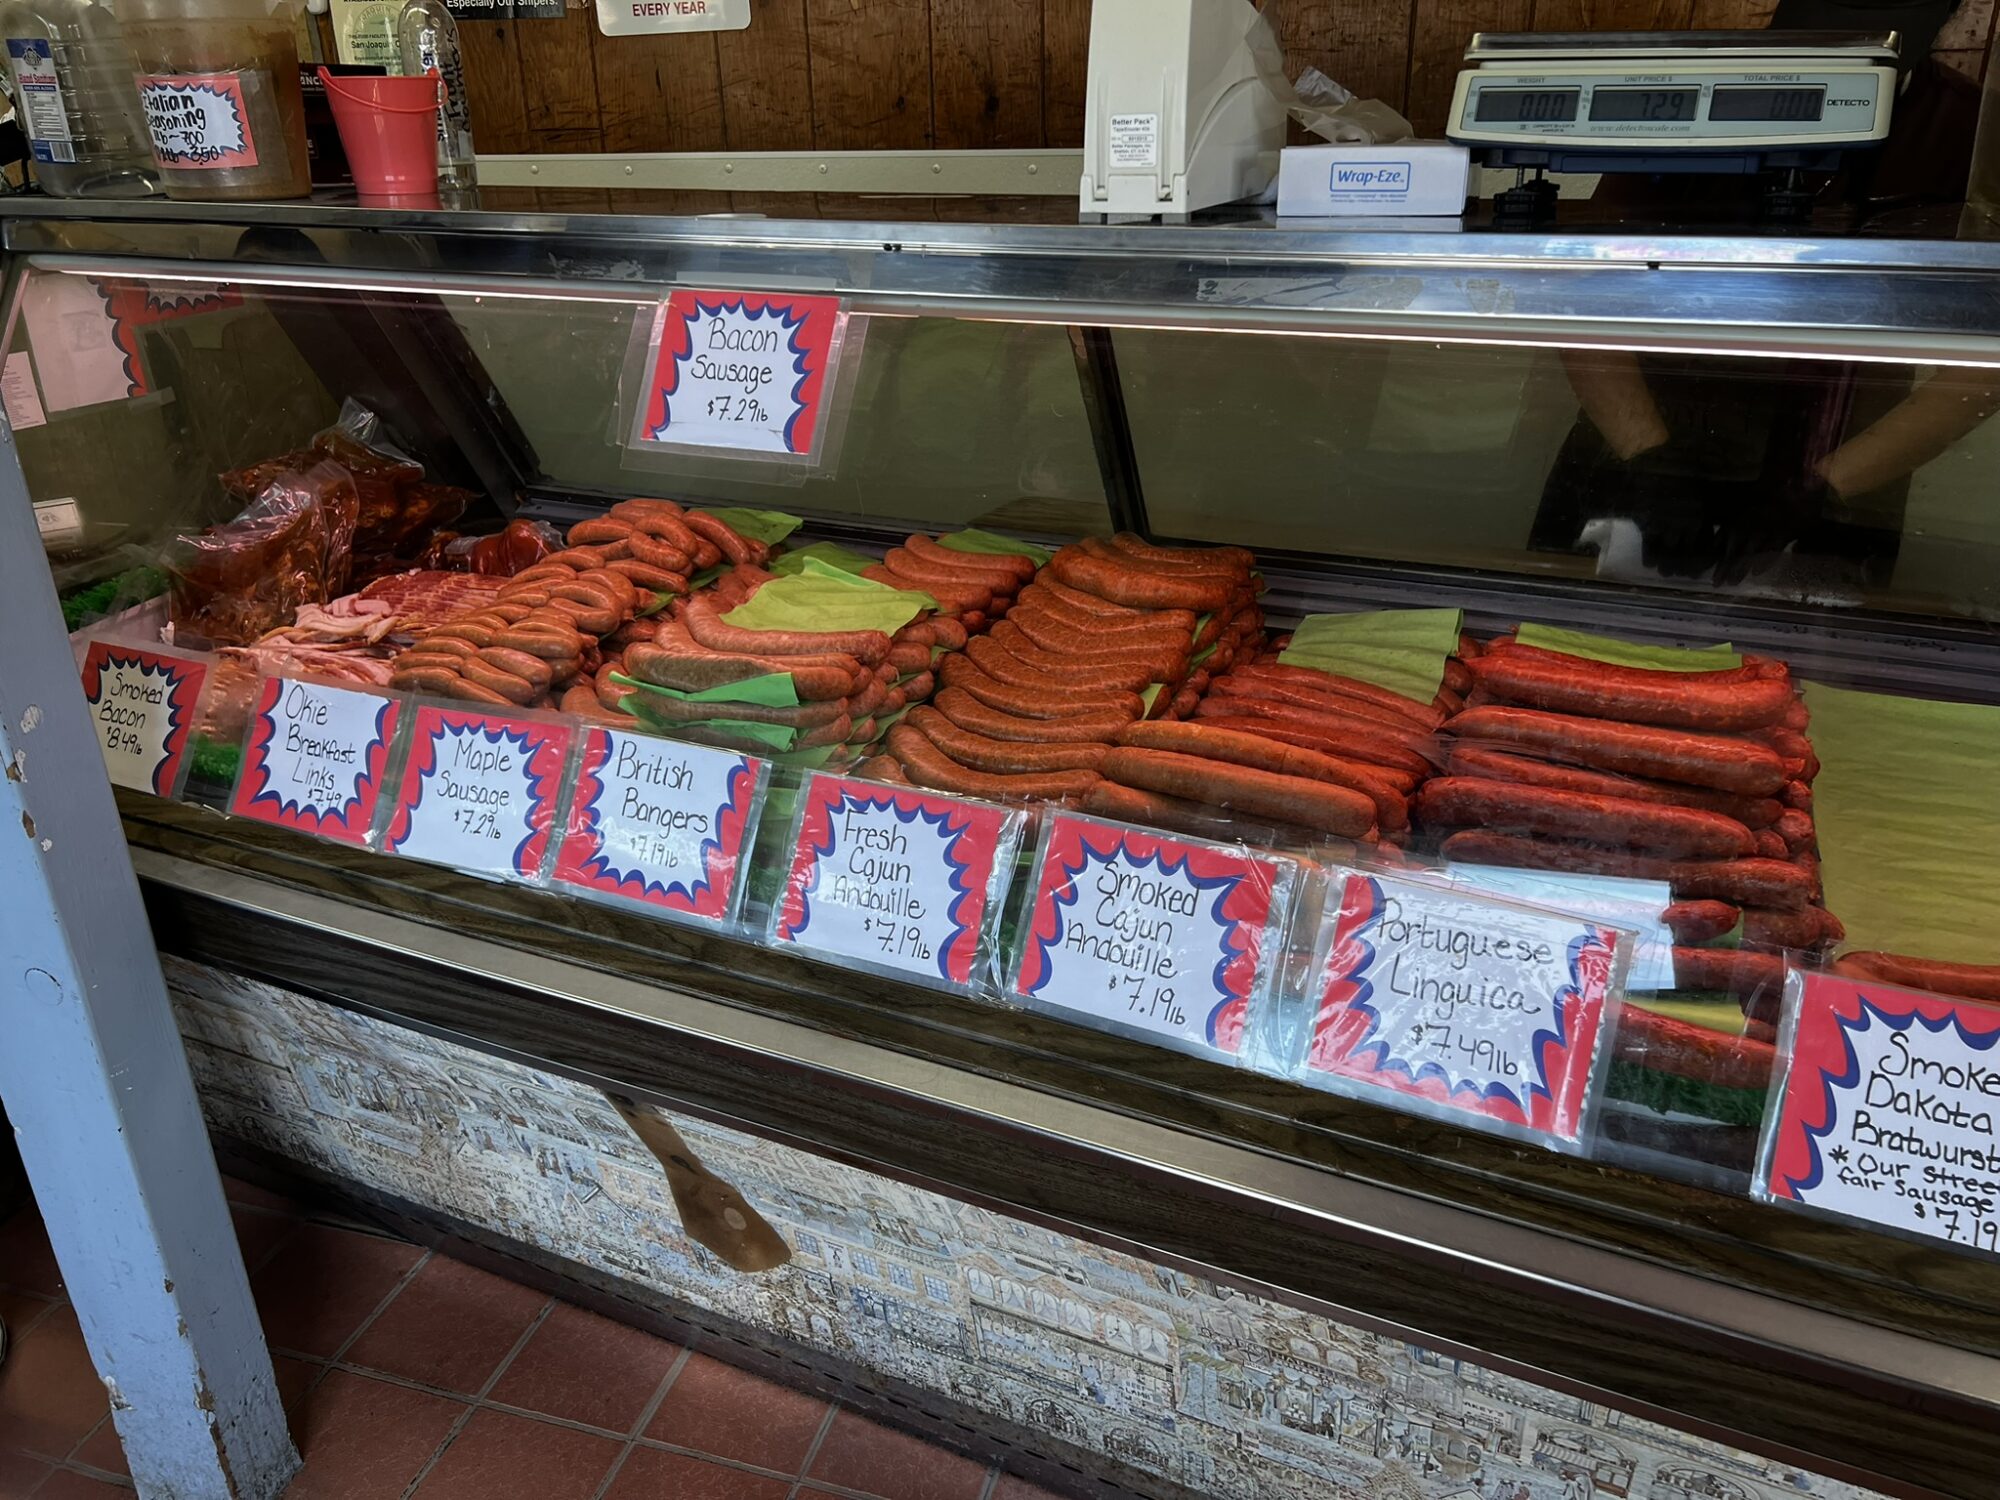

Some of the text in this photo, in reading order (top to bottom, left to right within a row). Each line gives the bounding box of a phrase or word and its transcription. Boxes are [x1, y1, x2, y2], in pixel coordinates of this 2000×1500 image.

[632, 1, 706, 17] EVERY YEAR
[366, 40, 391, 49] Joaqui
[1826, 99, 1870, 107] DETECTO
[1338, 169, 1401, 187] Wrap-Eze
[708, 317, 778, 353] Bacon
[691, 354, 773, 394] Sausage
[111, 672, 164, 704] Smoked
[285, 684, 328, 725] Okie
[99, 699, 146, 729] Bacon
[286, 723, 356, 764] Breakfast
[454, 738, 512, 776] Maple
[292, 757, 335, 790] Links
[616, 740, 694, 792] British
[437, 770, 510, 815] Sausage
[621, 787, 709, 839] Bangers
[844, 808, 907, 854] Fresh
[849, 847, 912, 885] Cajun
[833, 875, 926, 919] Andouille
[1096, 861, 1200, 917] Smoked
[1095, 897, 1173, 946] Cajun
[1376, 897, 1554, 970] Portuguese
[1065, 919, 1178, 979] Andouille
[1390, 953, 1541, 1020] Linguica
[1865, 1070, 1993, 1135] Dakota
[1852, 1109, 2000, 1174] Bratwurst
[1837, 1166, 1886, 1191] fair
